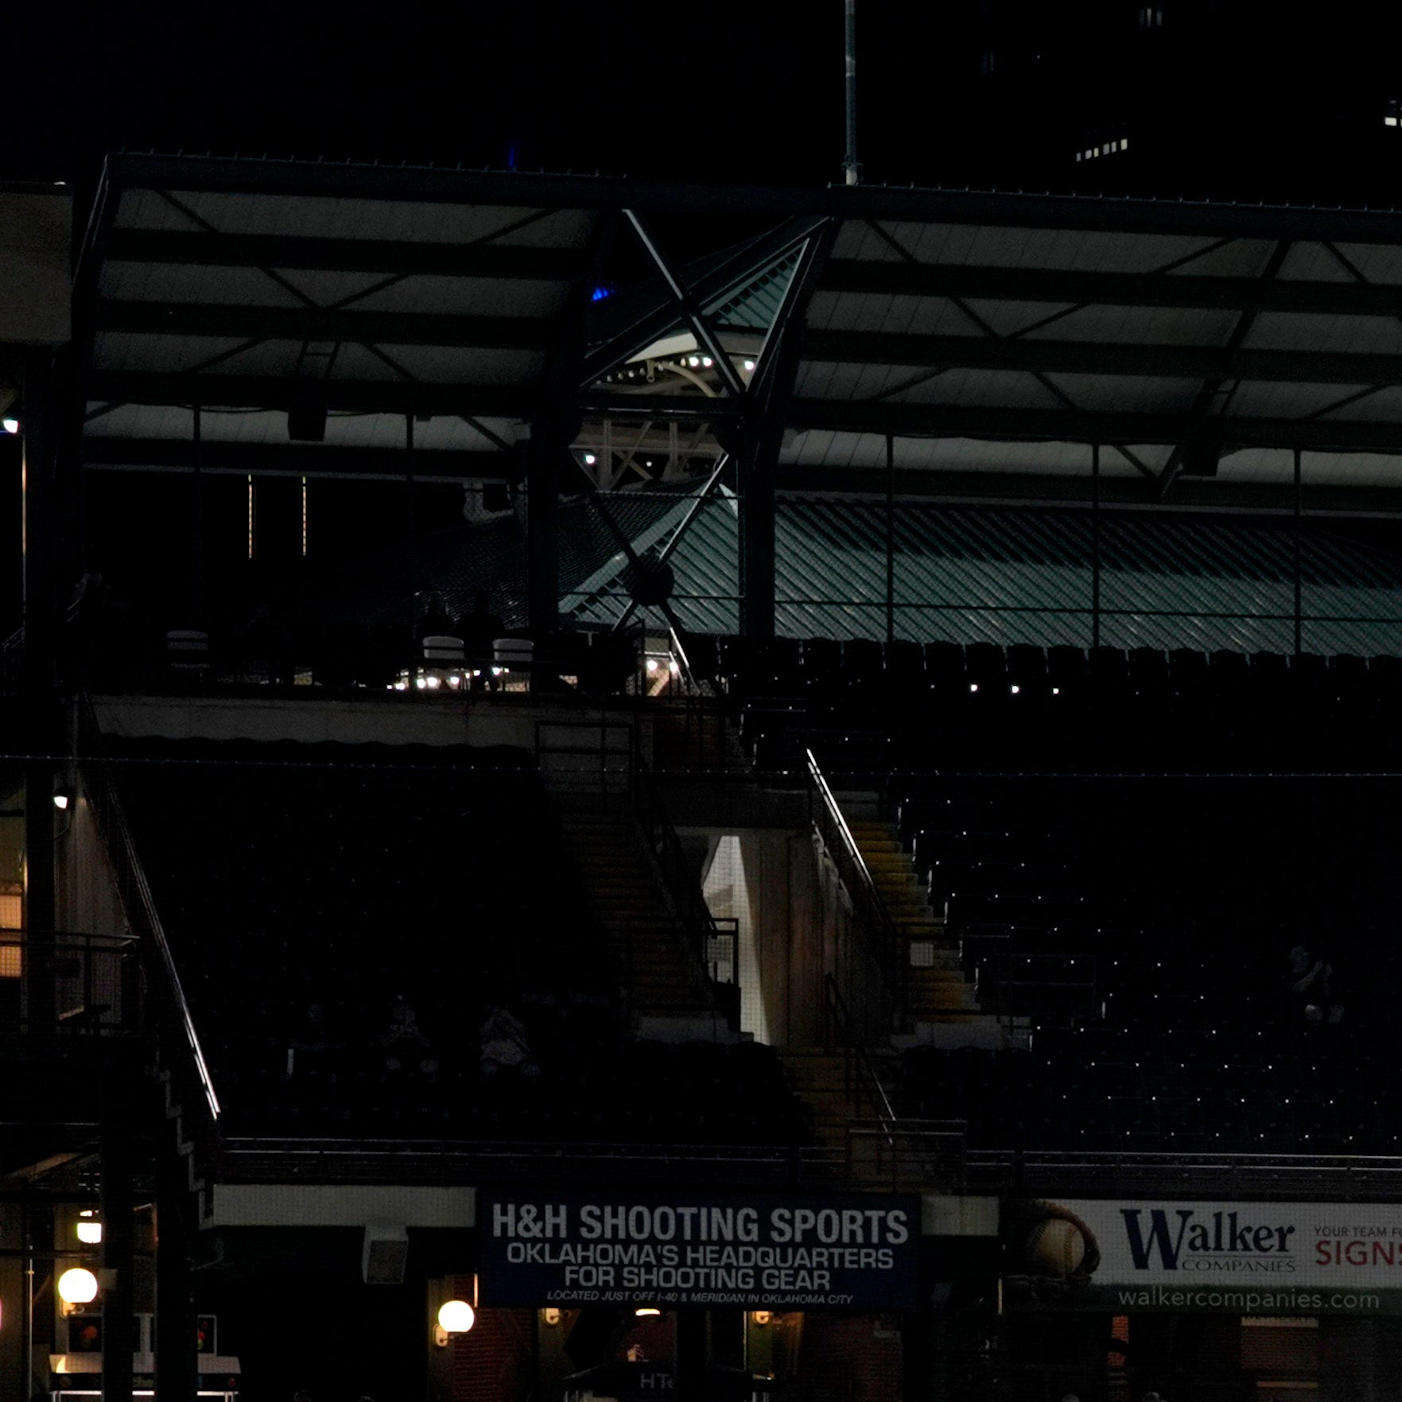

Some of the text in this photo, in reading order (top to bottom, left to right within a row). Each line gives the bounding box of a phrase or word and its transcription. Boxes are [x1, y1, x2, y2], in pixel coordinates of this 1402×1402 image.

[492, 1203, 909, 1246] H&H SHOOTING SPORTS
[1314, 1226, 1349, 1237] YOUR
[1352, 1226, 1388, 1238] TEAM
[1120, 1209, 1296, 1271] Walker
[506, 1242, 894, 1270] OKLAHOMA'S HEADQUARTERS
[1182, 1257, 1296, 1273] COMPANIES
[564, 1266, 831, 1291] FOR SHOOTING GEAR
[547, 1290, 598, 1301] LOCATED
[599, 1290, 631, 1302] JUST
[632, 1291, 656, 1302] OFF
[690, 1292, 746, 1304] MERIDIAN
[748, 1293, 759, 1304] IN
[761, 1293, 825, 1305] OKLAHOMA
[827, 1294, 855, 1305] CITY
[1119, 1287, 1380, 1311] walkercompanies.com
